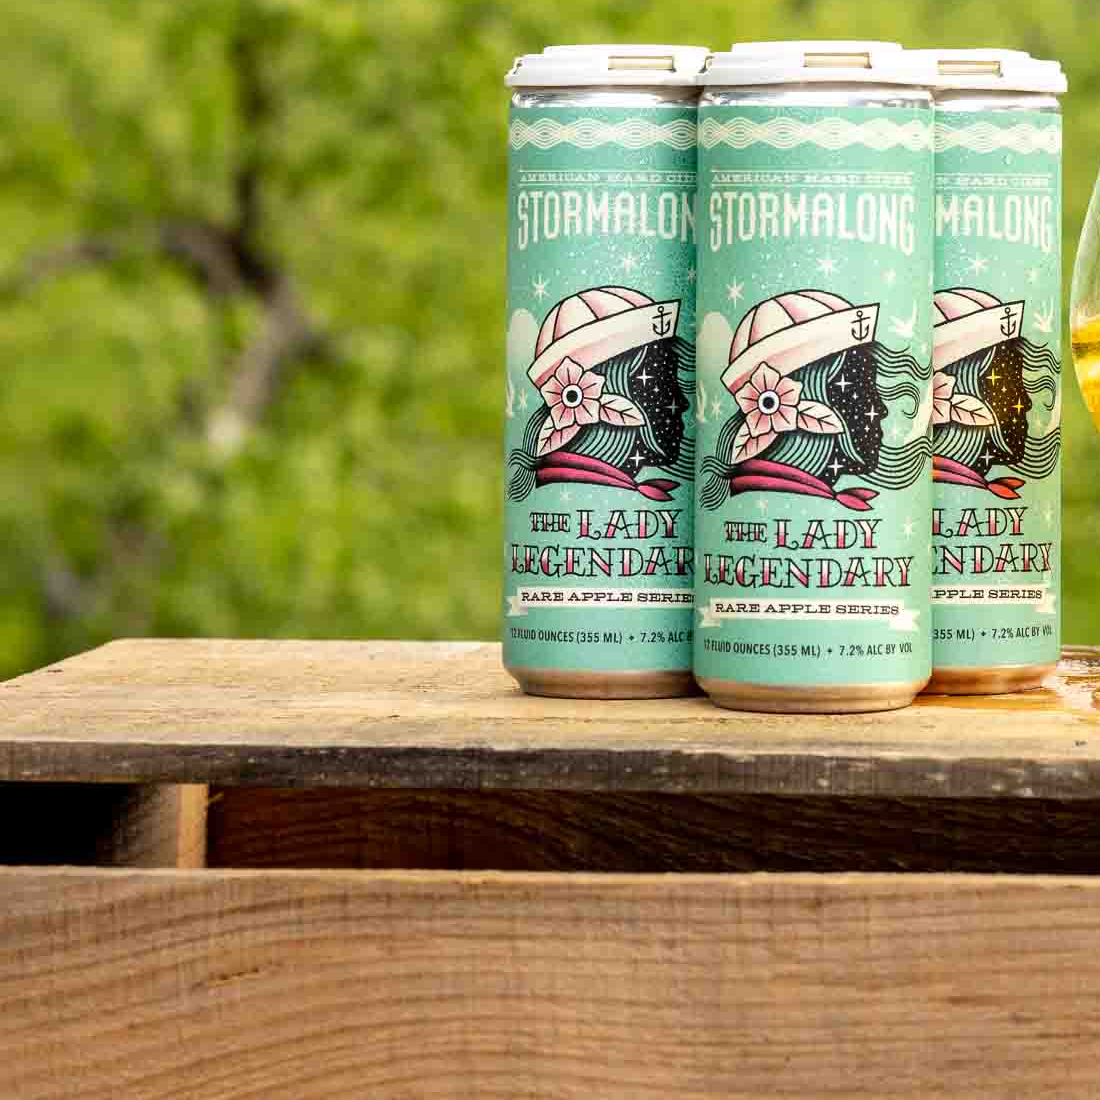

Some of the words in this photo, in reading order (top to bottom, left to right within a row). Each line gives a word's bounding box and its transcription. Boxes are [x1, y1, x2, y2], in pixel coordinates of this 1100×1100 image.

[518, 190, 697, 251] STORMALON
[709, 191, 915, 256] STORMALONG
[935, 194, 1051, 252] MALONG
[529, 512, 572, 533] THE
[576, 509, 683, 540] LADY
[723, 521, 768, 543] THE
[773, 518, 883, 550] LADY
[932, 507, 1029, 538] LADY
[511, 544, 696, 578] LEGENDAR
[704, 553, 914, 588] LEGENDARY
[932, 543, 1053, 574] NDARY
[521, 592, 564, 602] RARE
[568, 592, 633, 602] APPLE
[637, 592, 696, 604] SERIE
[715, 603, 760, 614] RARE
[764, 603, 831, 614] APPLE
[835, 604, 900, 615] SERIES
[932, 589, 985, 599] PPLE
[988, 589, 1043, 599] SERIES
[517, 628, 536, 641] FLUID
[538, 631, 574, 643] OUNCES
[576, 631, 600, 645] (355
[603, 632, 623, 645] ML)
[640, 632, 666, 643] 7.2%
[668, 631, 683, 643] ALC
[711, 639, 731, 653] FLUID
[733, 642, 771, 656] OUNCES
[773, 643, 798, 658] (355
[801, 644, 821, 658] ML)
[839, 644, 865, 657] 7.2%
[866, 643, 883, 656] ALC
[885, 643, 896, 655] BY
[933, 628, 953, 640] 355
[956, 628, 975, 641] ML)
[991, 628, 1014, 639] 7.2%
[1015, 627, 1030, 638] ALC
[1031, 626, 1041, 637] BY
